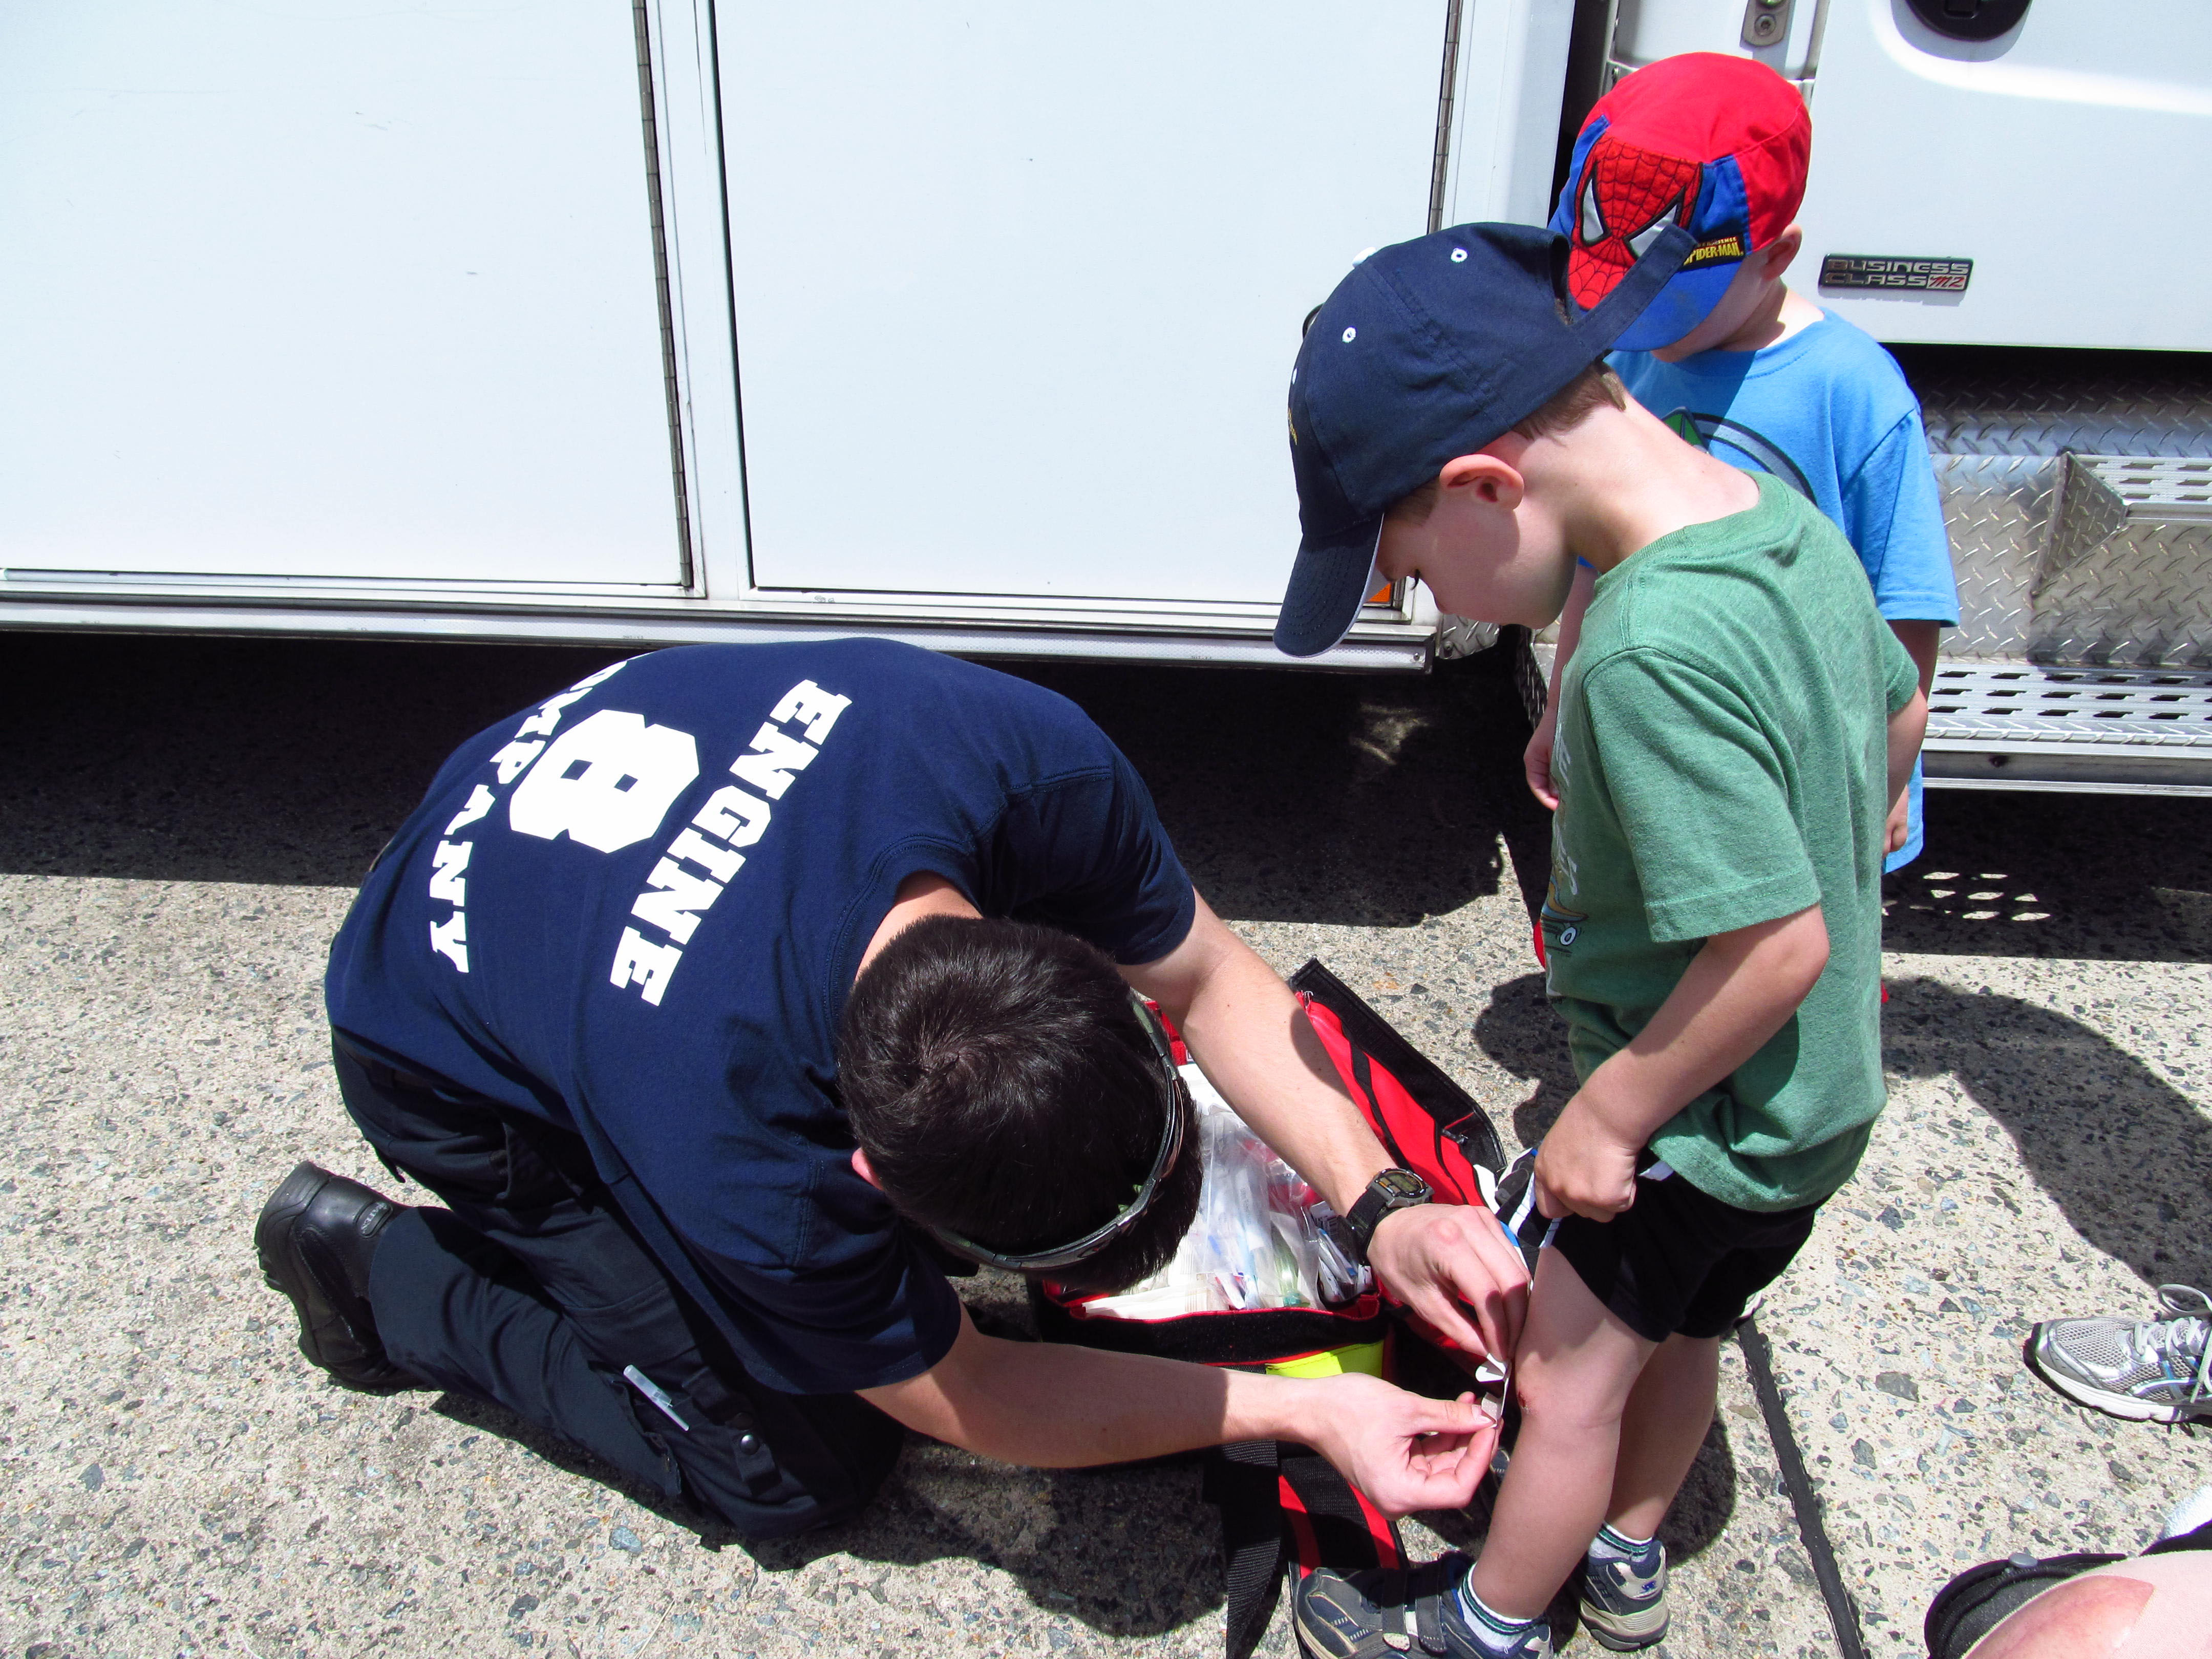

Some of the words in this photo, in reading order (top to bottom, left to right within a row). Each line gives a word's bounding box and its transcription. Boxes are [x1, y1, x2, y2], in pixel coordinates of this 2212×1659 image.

[1683, 241, 1740, 266] PIDER-MAN
[1824, 272, 1927, 287] CLASS
[1827, 258, 1970, 275] BUSINESS
[429, 651, 655, 973] OMPANY
[509, 709, 700, 854] 8
[609, 679, 853, 1006] ENGINE
